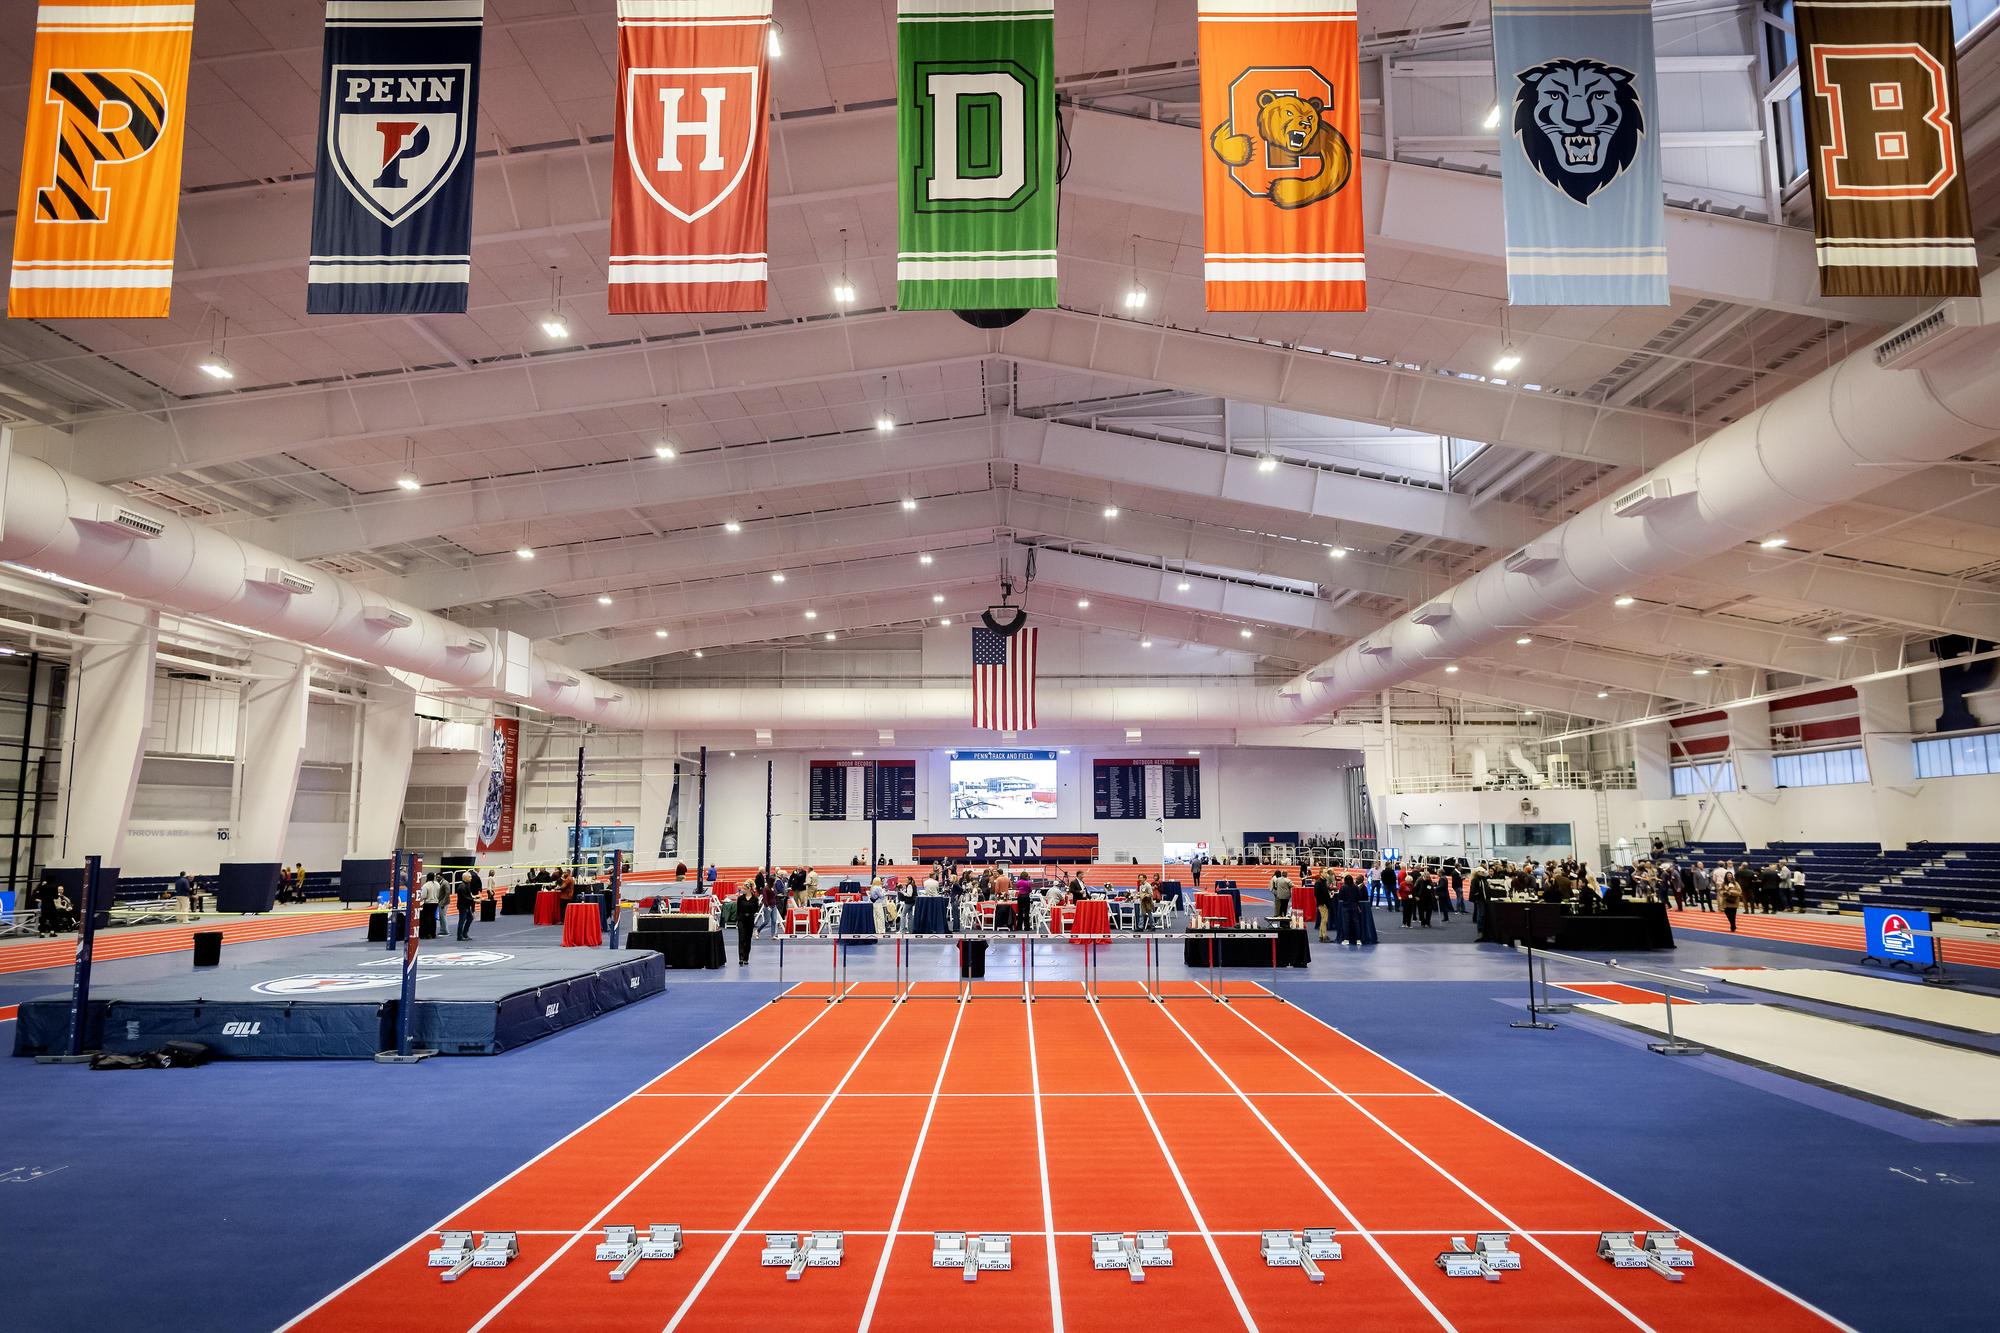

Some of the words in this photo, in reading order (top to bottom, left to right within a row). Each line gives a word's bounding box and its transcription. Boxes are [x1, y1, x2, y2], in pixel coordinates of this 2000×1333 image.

[345, 77, 452, 103] PENN
[657, 86, 727, 172] H
[1810, 43, 1957, 201] B
[35, 68, 169, 224] P
[918, 64, 1034, 208] D
[372, 121, 431, 189] P
[973, 752, 988, 760] PENN
[989, 752, 1006, 760] TRACK
[1007, 752, 1018, 760] AND
[1018, 752, 1034, 760] FIELD
[128, 829, 165, 838] THROWS
[965, 836, 1045, 858] PENN
[221, 1021, 261, 1035] GILL
[1448, 1269, 1480, 1277] FUSION
[1616, 1260, 1647, 1268] FUSION
